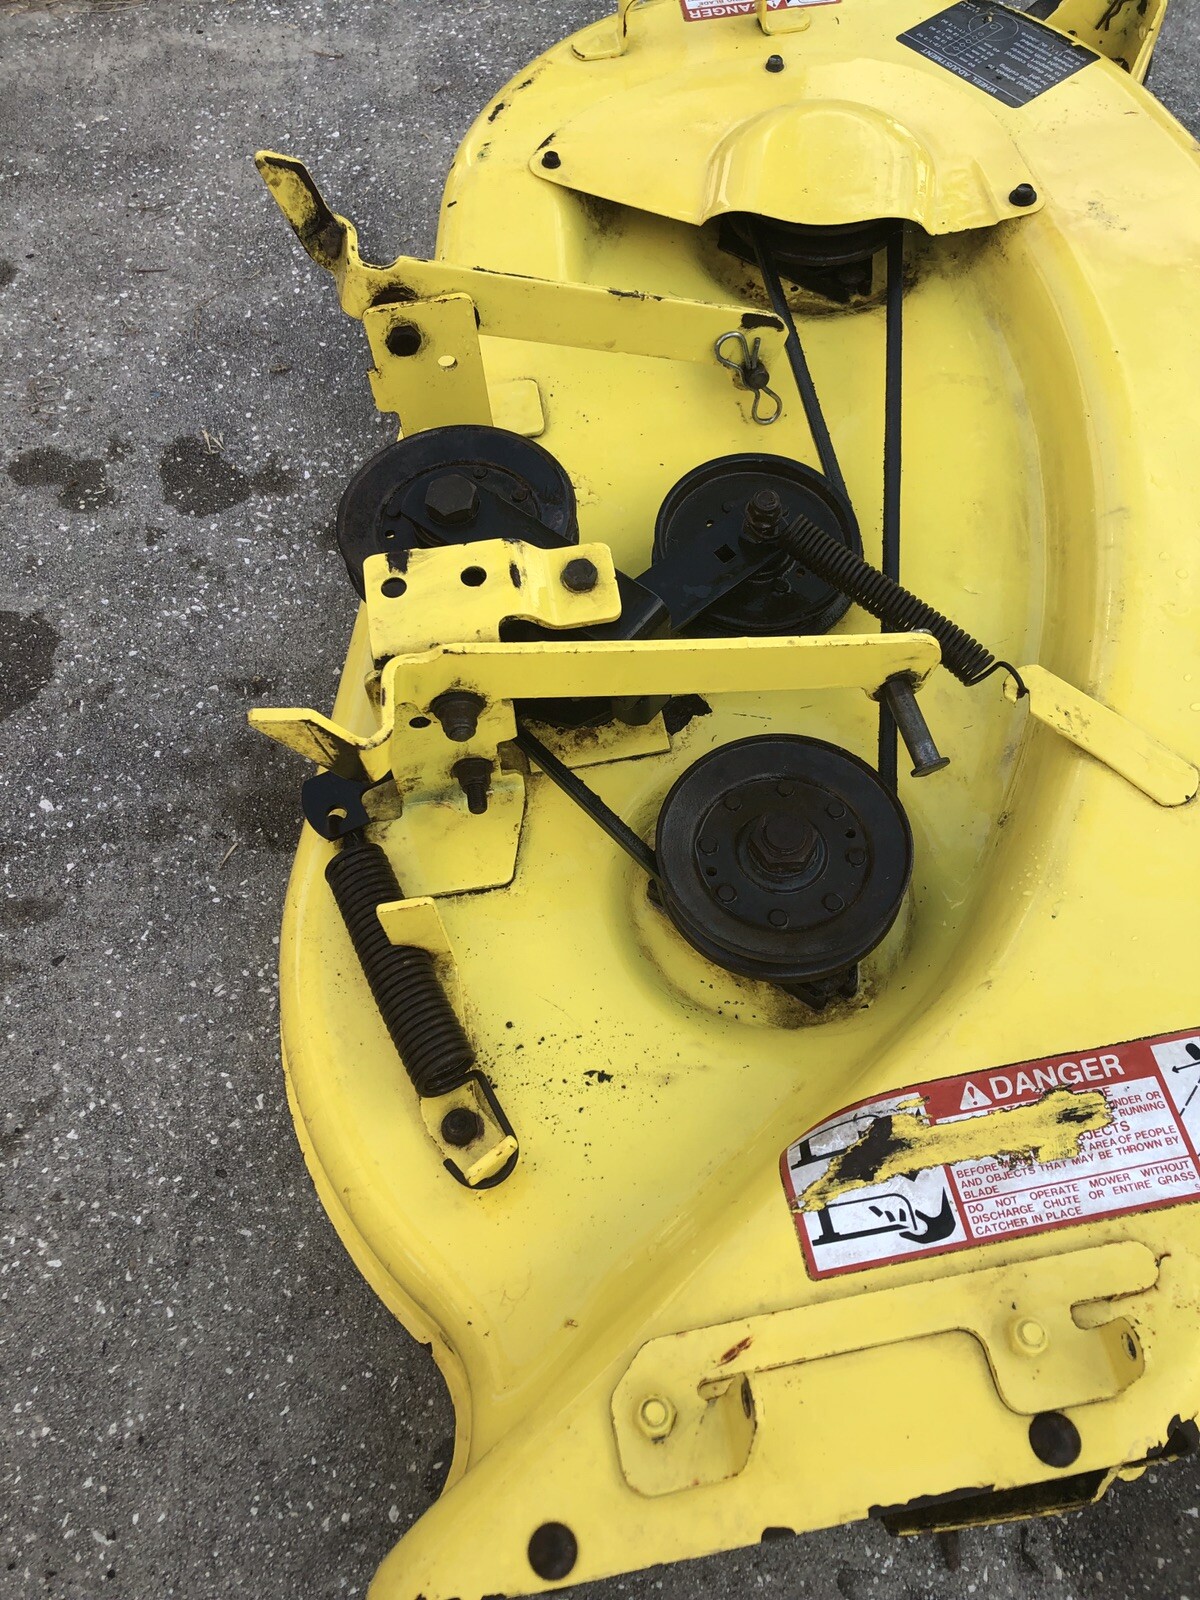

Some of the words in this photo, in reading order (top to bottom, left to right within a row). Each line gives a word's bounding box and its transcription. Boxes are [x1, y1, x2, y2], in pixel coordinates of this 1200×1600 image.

[689, 4, 754, 19] ANGER
[1009, 47, 1031, 59] mower
[1013, 41, 1034, 53] mower
[1018, 38, 1052, 56] suspended
[920, 47, 971, 77] ADJUSTMENT
[1003, 50, 1027, 64] control
[1033, 52, 1047, 61] with
[1051, 56, 1074, 68] wheels
[997, 62, 1019, 76] cutting
[1025, 62, 1044, 74] depth
[1030, 58, 1054, 72] support
[1047, 60, 1067, 72] weight
[993, 68, 1016, 81] wheels
[1018, 75, 1042, 88] desired
[968, 75, 997, 93] WHEEL
[988, 1053, 1125, 1099] DANGER
[1144, 1091, 1161, 1100] OR
[1117, 1100, 1165, 1117] RUNNING
[1087, 1138, 1117, 1150] AREA
[1117, 1134, 1132, 1143] OF
[1134, 1124, 1176, 1139] PEOPLE
[960, 1177, 982, 1188] AND
[985, 1165, 1035, 1184] OBJECTS
[1039, 1159, 1066, 1171] THAT
[1070, 1153, 1094, 1165] MAY
[1097, 1149, 1113, 1159] BE
[1114, 1139, 1162, 1155] THROWN
[1164, 1135, 1179, 1145] BY
[956, 1162, 998, 1178] BEFORE
[963, 1185, 999, 1200] BLADE
[967, 1202, 984, 1213] DO
[995, 1195, 1017, 1208] NOT
[1028, 1183, 1079, 1200] OPERATE
[1088, 1172, 1130, 1188] MOWER
[1139, 1160, 1190, 1177] WITHOUT
[971, 1203, 1035, 1224] DISCHARGE
[1042, 1194, 1080, 1209] CHUTE
[1087, 1189, 1105, 1200] OR
[1111, 1179, 1152, 1195] ENTIRE
[1156, 1170, 1196, 1185] GRASS
[975, 1217, 1029, 1236] CATCHER
[1031, 1213, 1045, 1224] IN
[1047, 1206, 1083, 1221] PLACE
